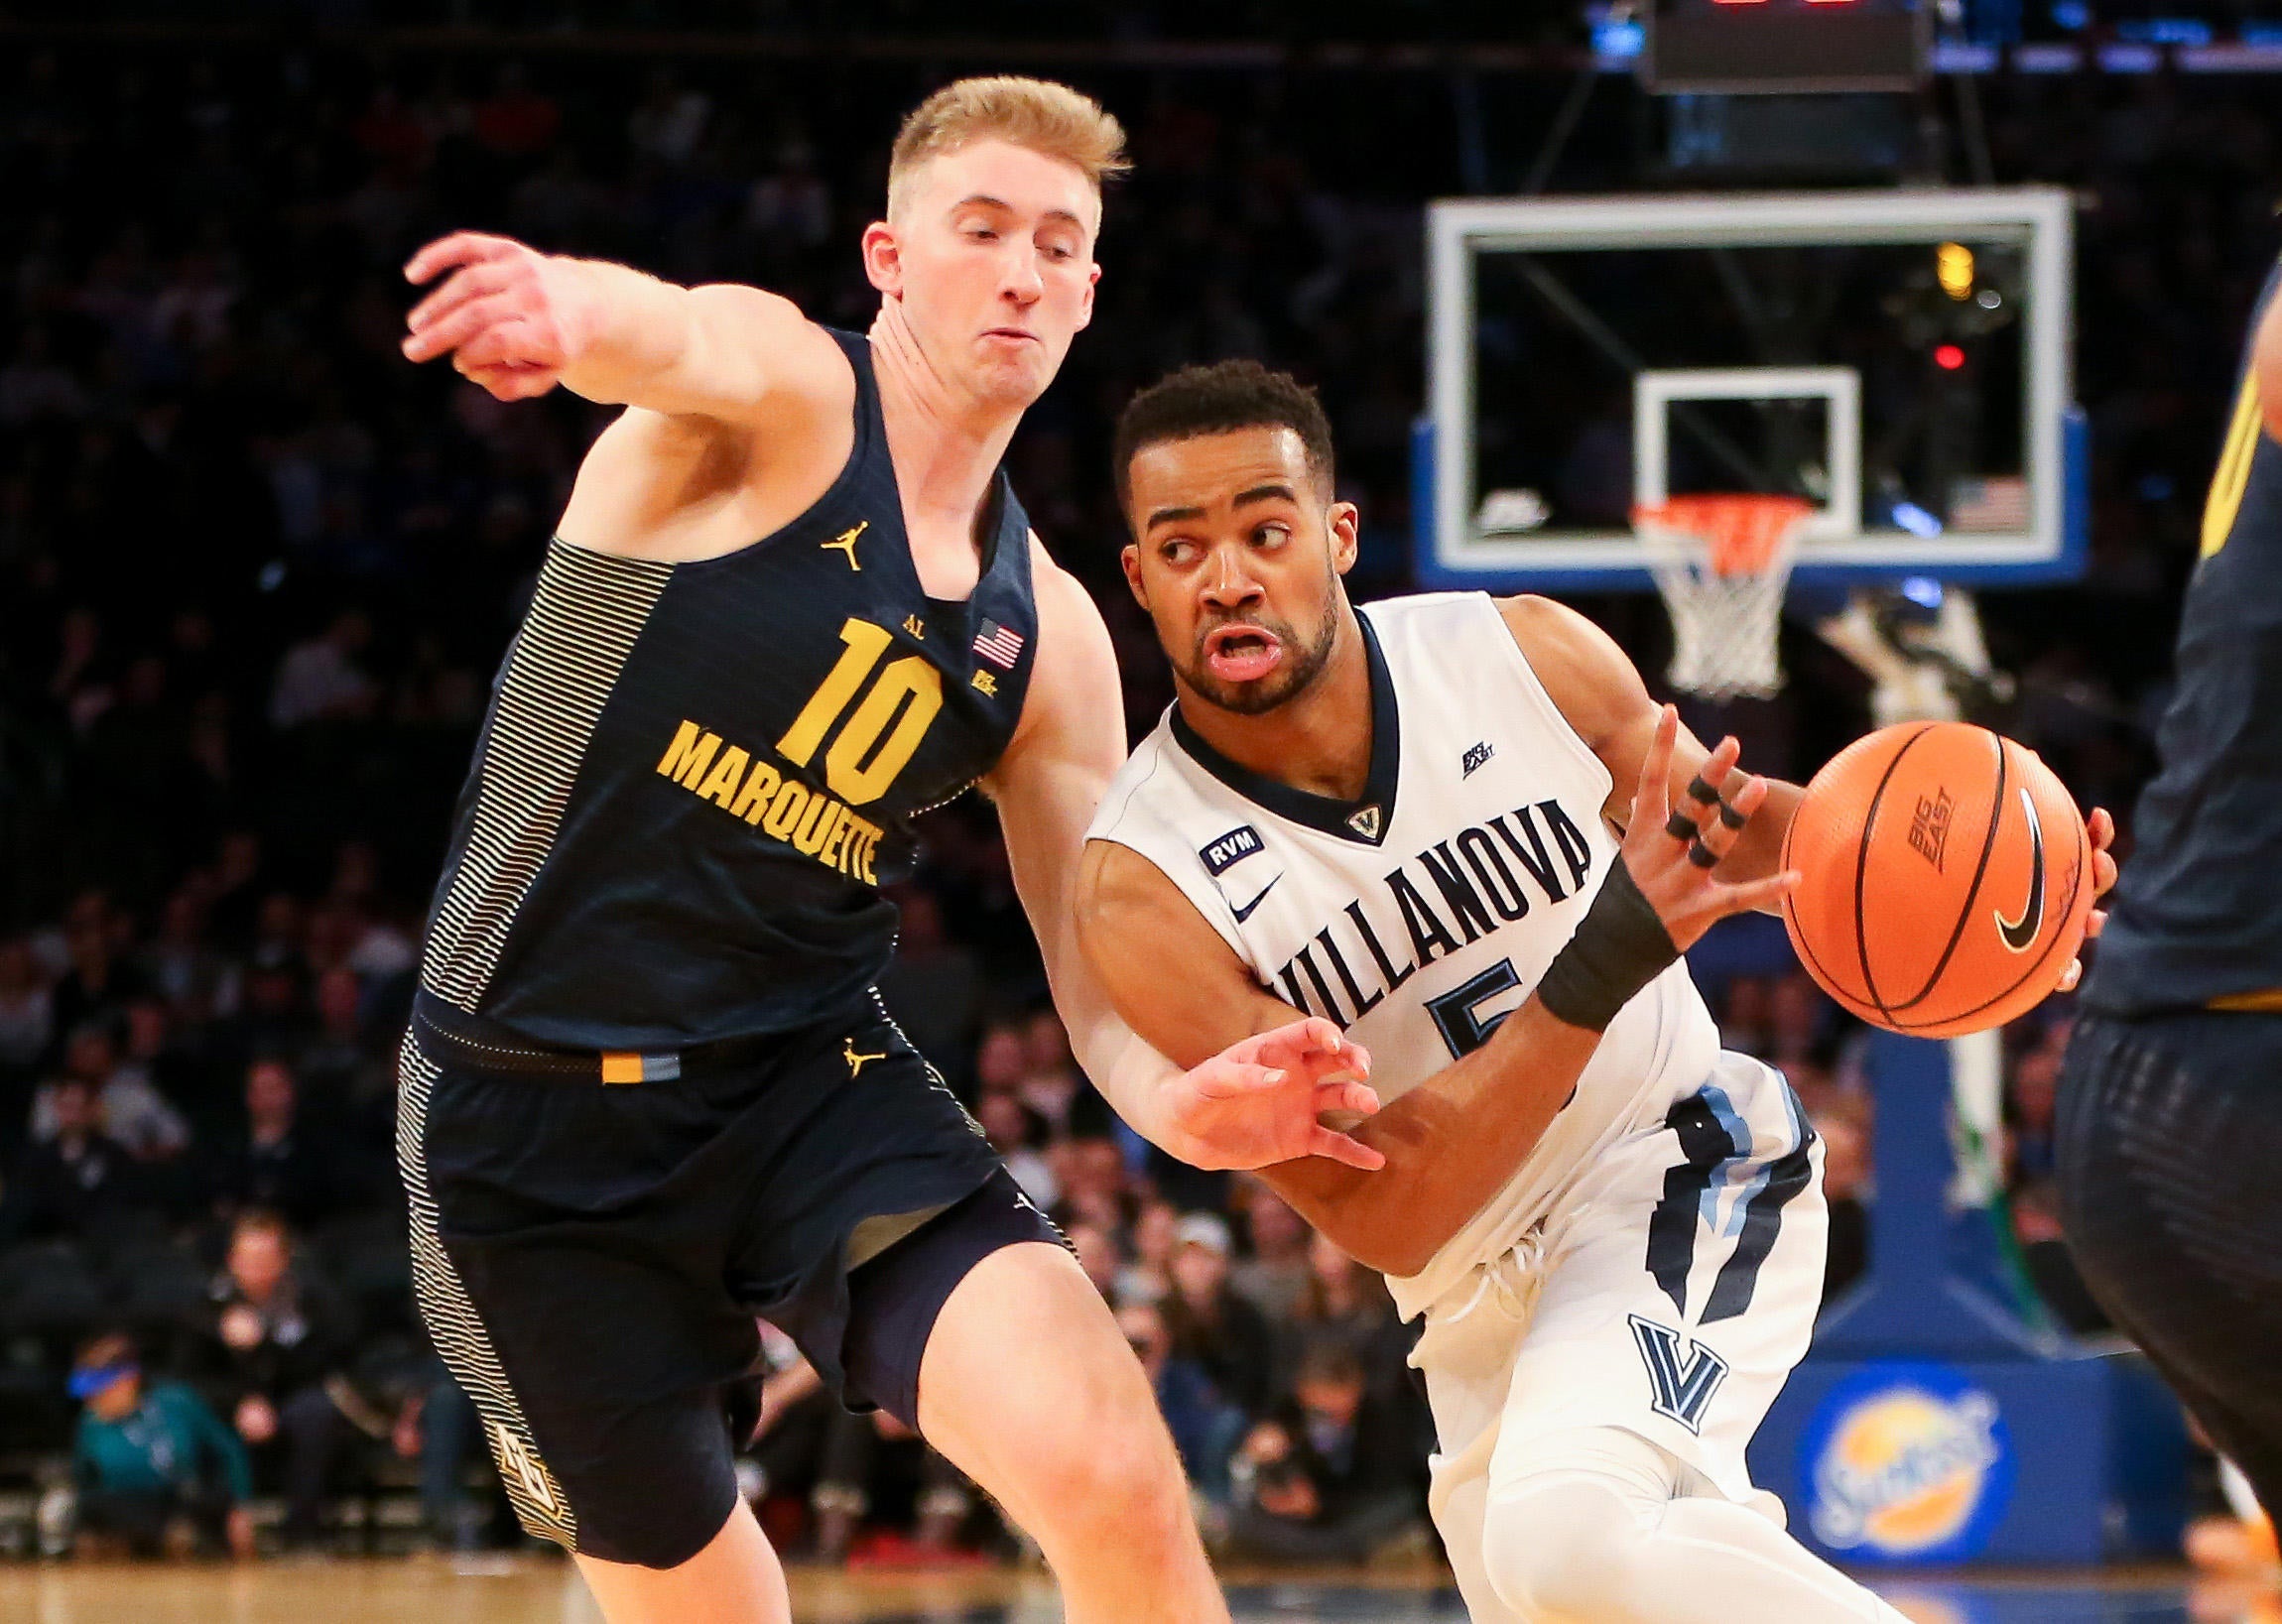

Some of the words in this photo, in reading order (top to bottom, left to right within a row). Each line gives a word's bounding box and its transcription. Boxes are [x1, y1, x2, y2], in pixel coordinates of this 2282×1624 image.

[775, 617, 944, 806] 10
[656, 719, 885, 886] MARQUETTE
[1208, 830, 1256, 866] RVM
[1908, 794, 1932, 854] BIG
[1923, 786, 1956, 875] EAST
[1627, 1313, 1729, 1437] V
